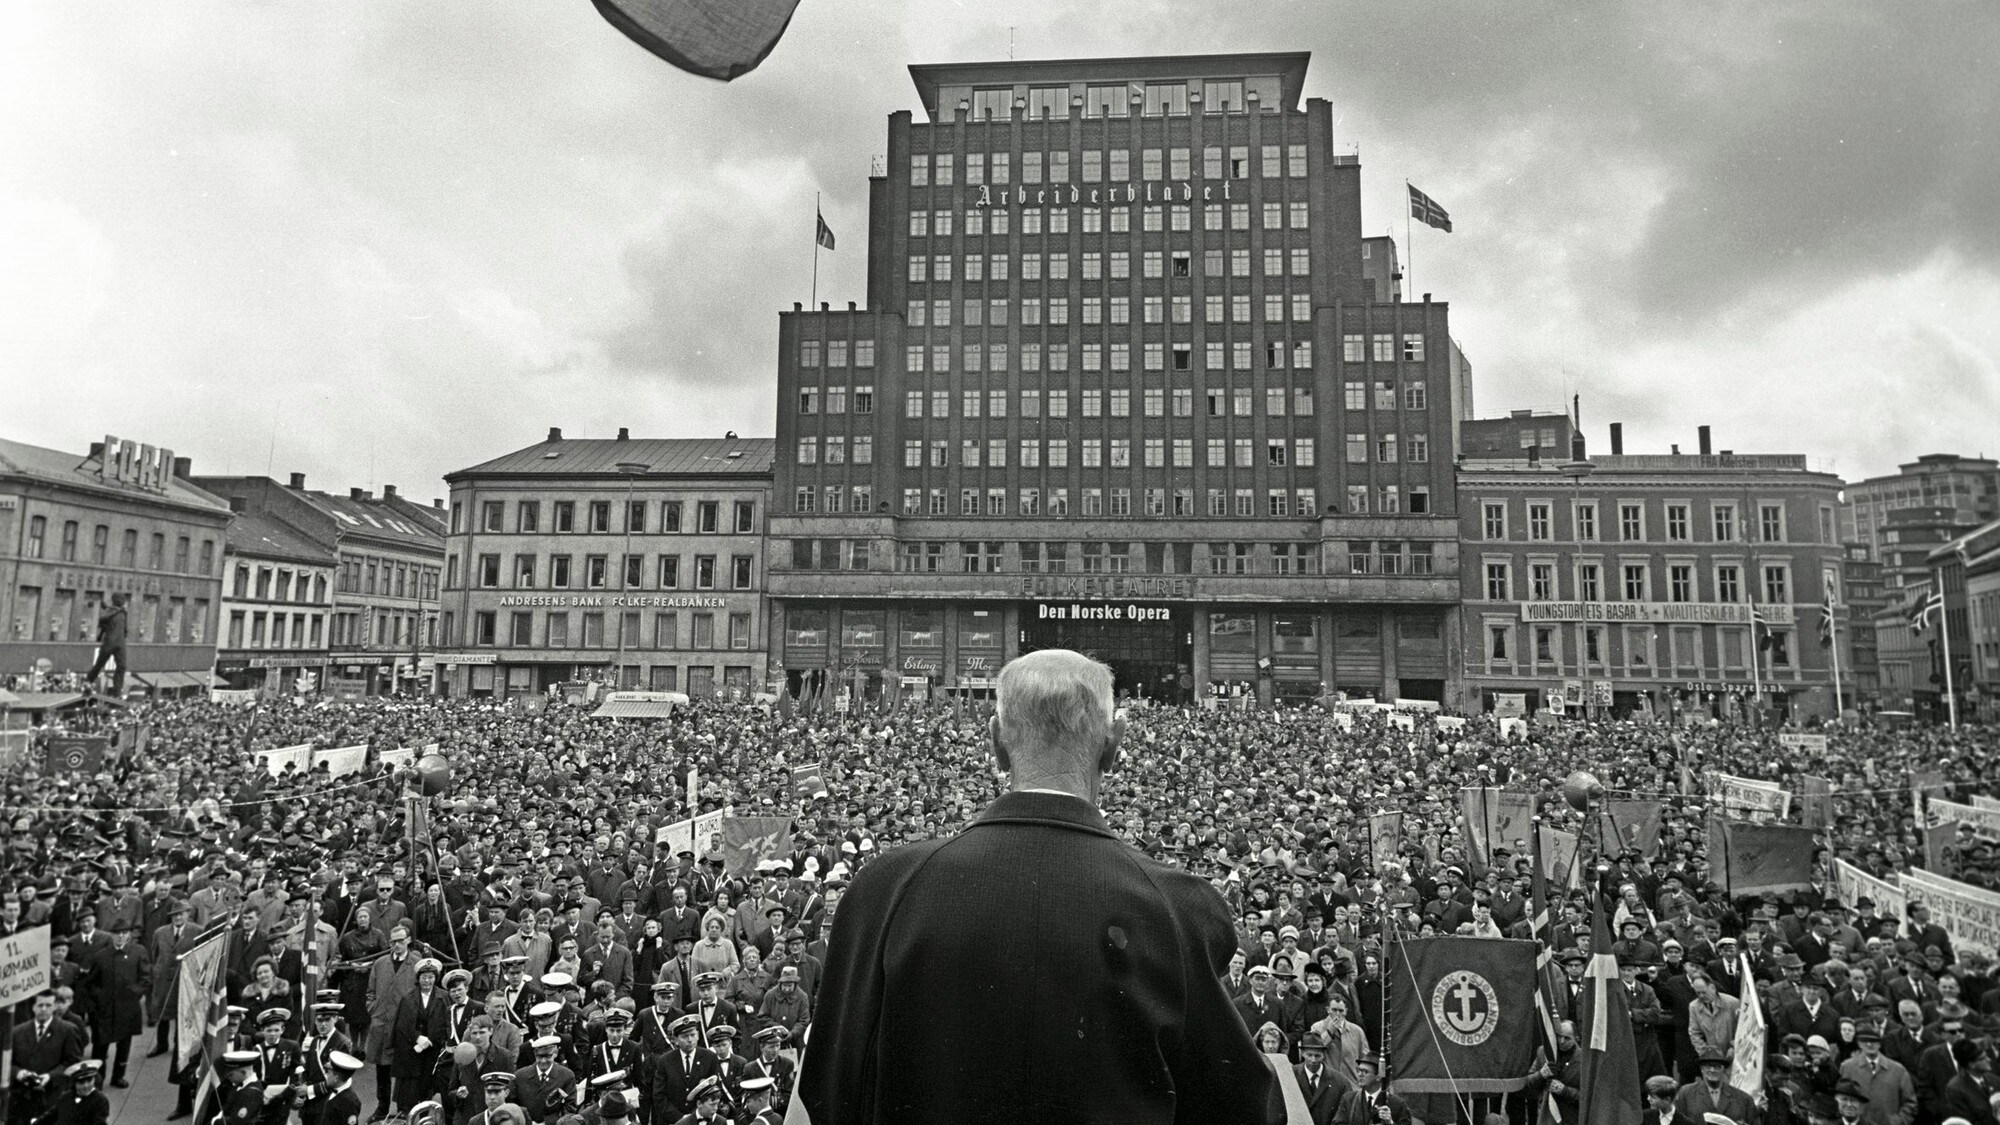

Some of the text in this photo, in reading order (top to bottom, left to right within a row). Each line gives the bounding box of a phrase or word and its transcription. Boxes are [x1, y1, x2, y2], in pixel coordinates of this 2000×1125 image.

[975, 180, 1232, 207] Arbeiderbladet
[102, 434, 175, 488] FORD
[500, 596, 566, 607] ANDRESENS
[571, 596, 602, 607] BANK
[1039, 604, 1170, 622] Den Norske Opera
[1606, 604, 1637, 620] BASAR
[1739, 605, 1787, 622] BIGERE
[903, 656, 937, 673] Erling
[1686, 682, 1786, 693] Oslo Spareank
